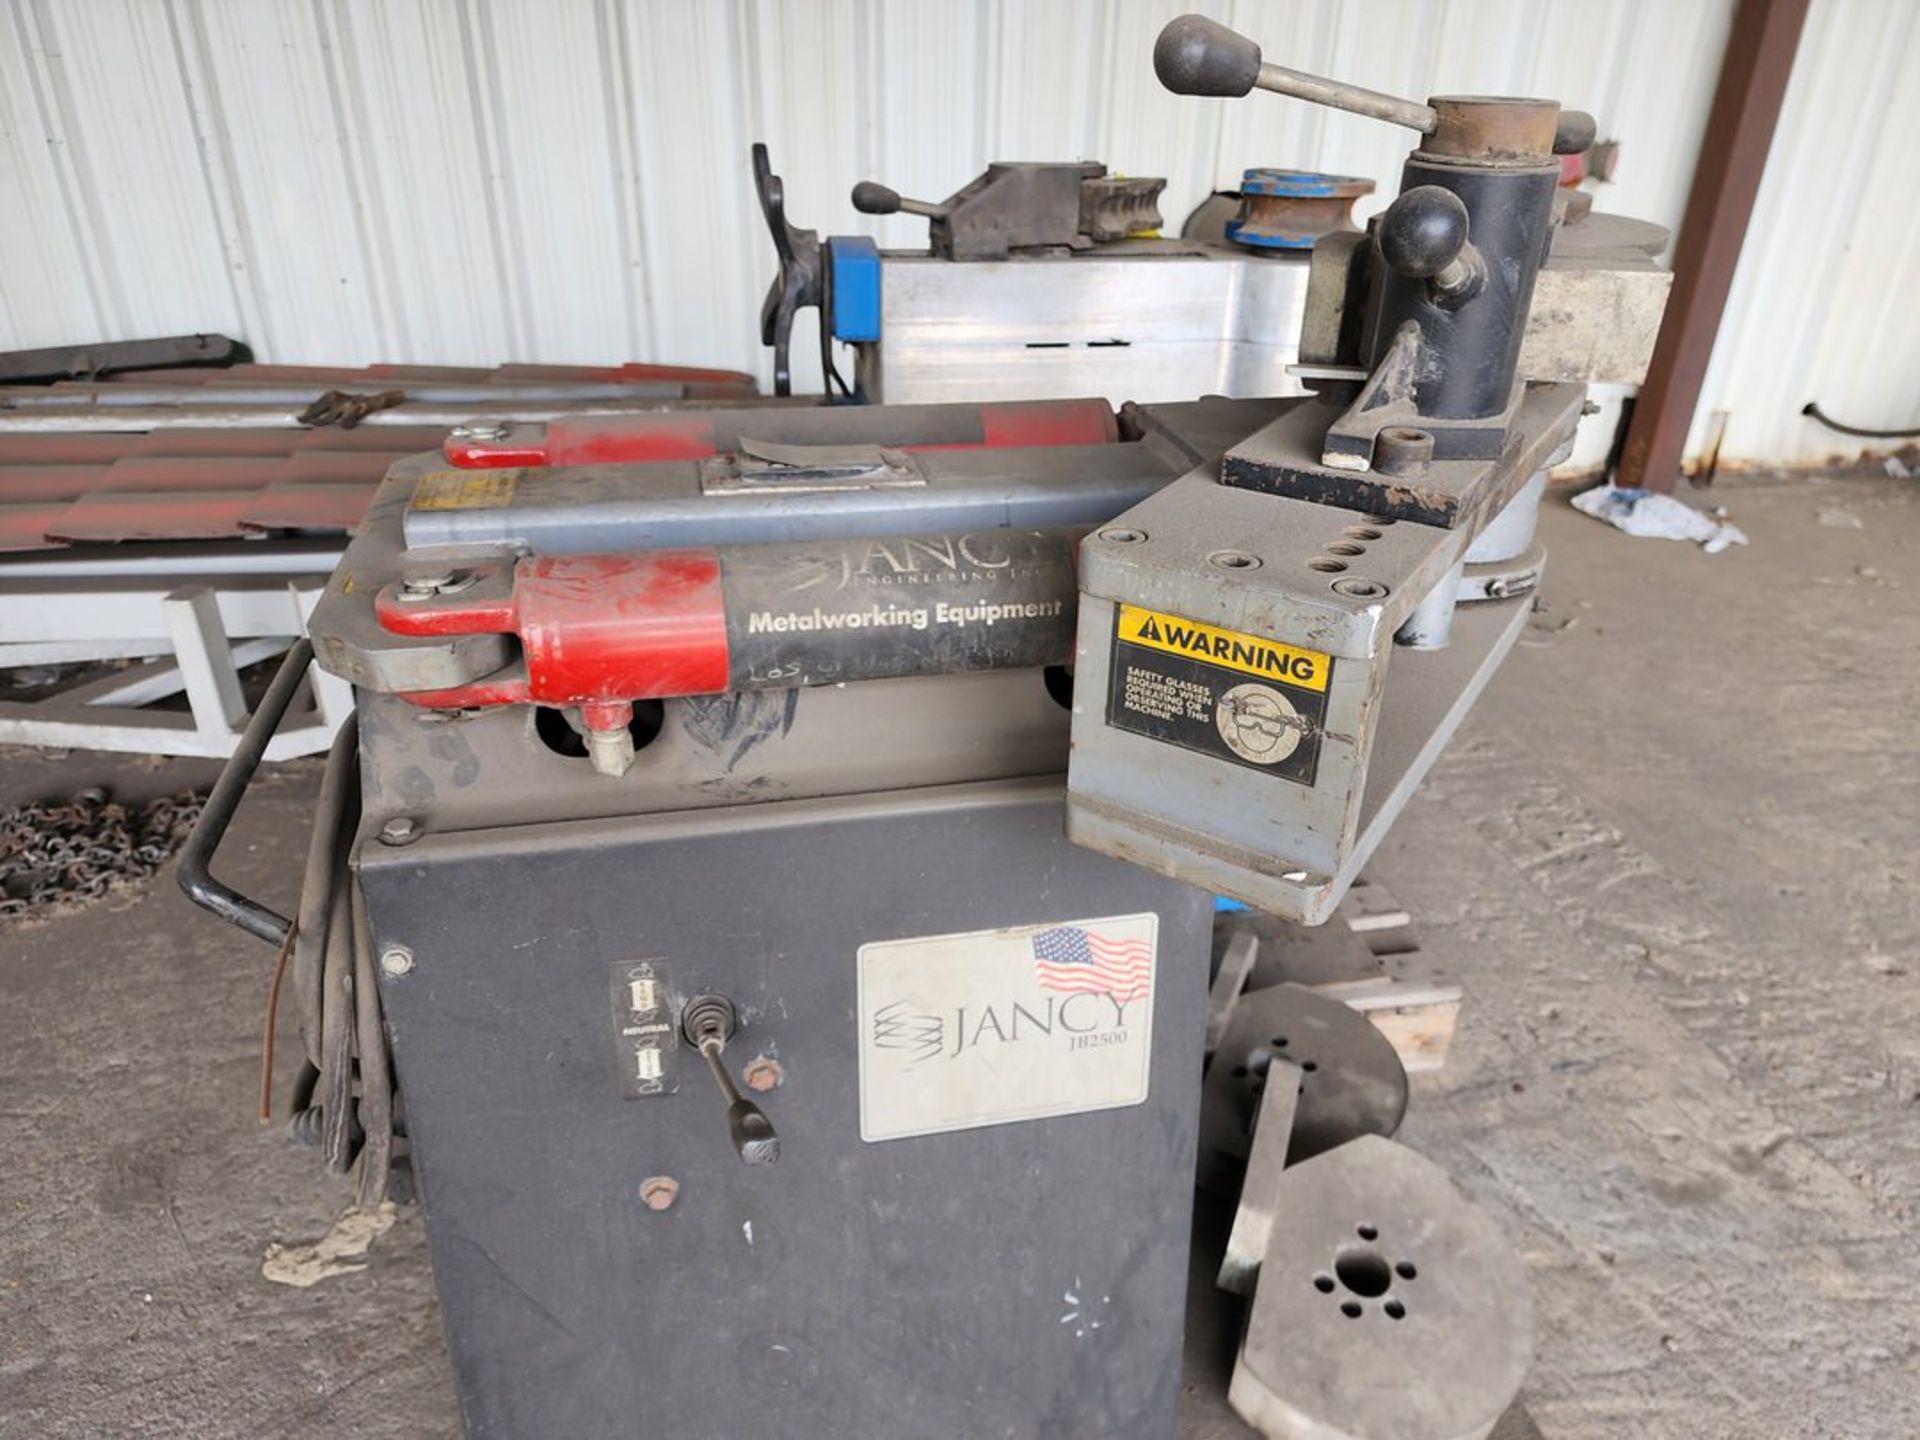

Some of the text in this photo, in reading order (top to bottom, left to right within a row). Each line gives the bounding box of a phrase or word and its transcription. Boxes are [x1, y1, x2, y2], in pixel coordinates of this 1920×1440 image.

[837, 532, 1042, 590] JANC
[748, 599, 1062, 633] Metalworking Equipment
[1164, 623, 1315, 681] WARNING
[1126, 675, 1212, 706] REQUIRED WHEN
[1127, 666, 1210, 696] SAFETY GLASSES
[1124, 692, 1209, 722] OBSERVING THIS
[1124, 701, 1174, 722] MACHINE.
[1125, 684, 1202, 712] OPERATING OR
[950, 986, 1137, 1059] JANCY
[1069, 1030, 1128, 1053] JB2500
